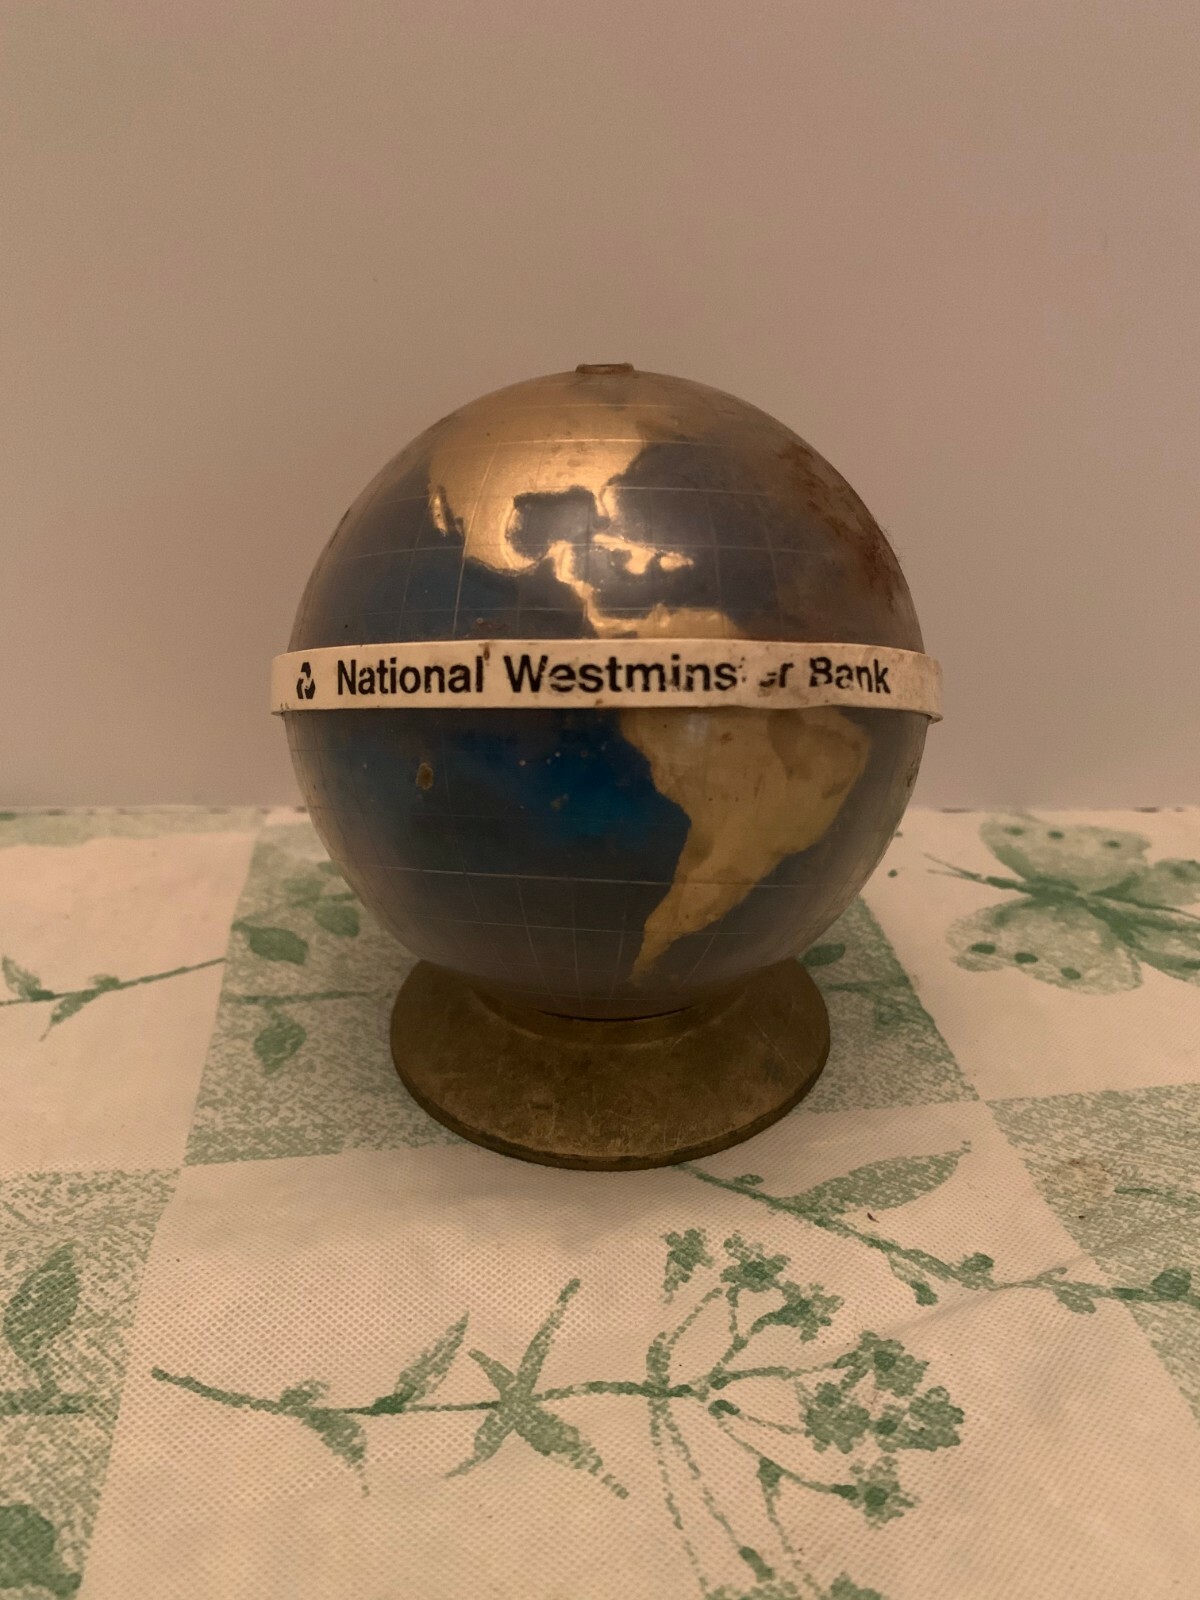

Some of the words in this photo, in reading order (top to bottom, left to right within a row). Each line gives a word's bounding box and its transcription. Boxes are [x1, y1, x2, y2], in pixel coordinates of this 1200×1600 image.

[337, 656, 484, 695] National
[503, 654, 794, 693] Westminsr
[808, 656, 891, 694] Bank
